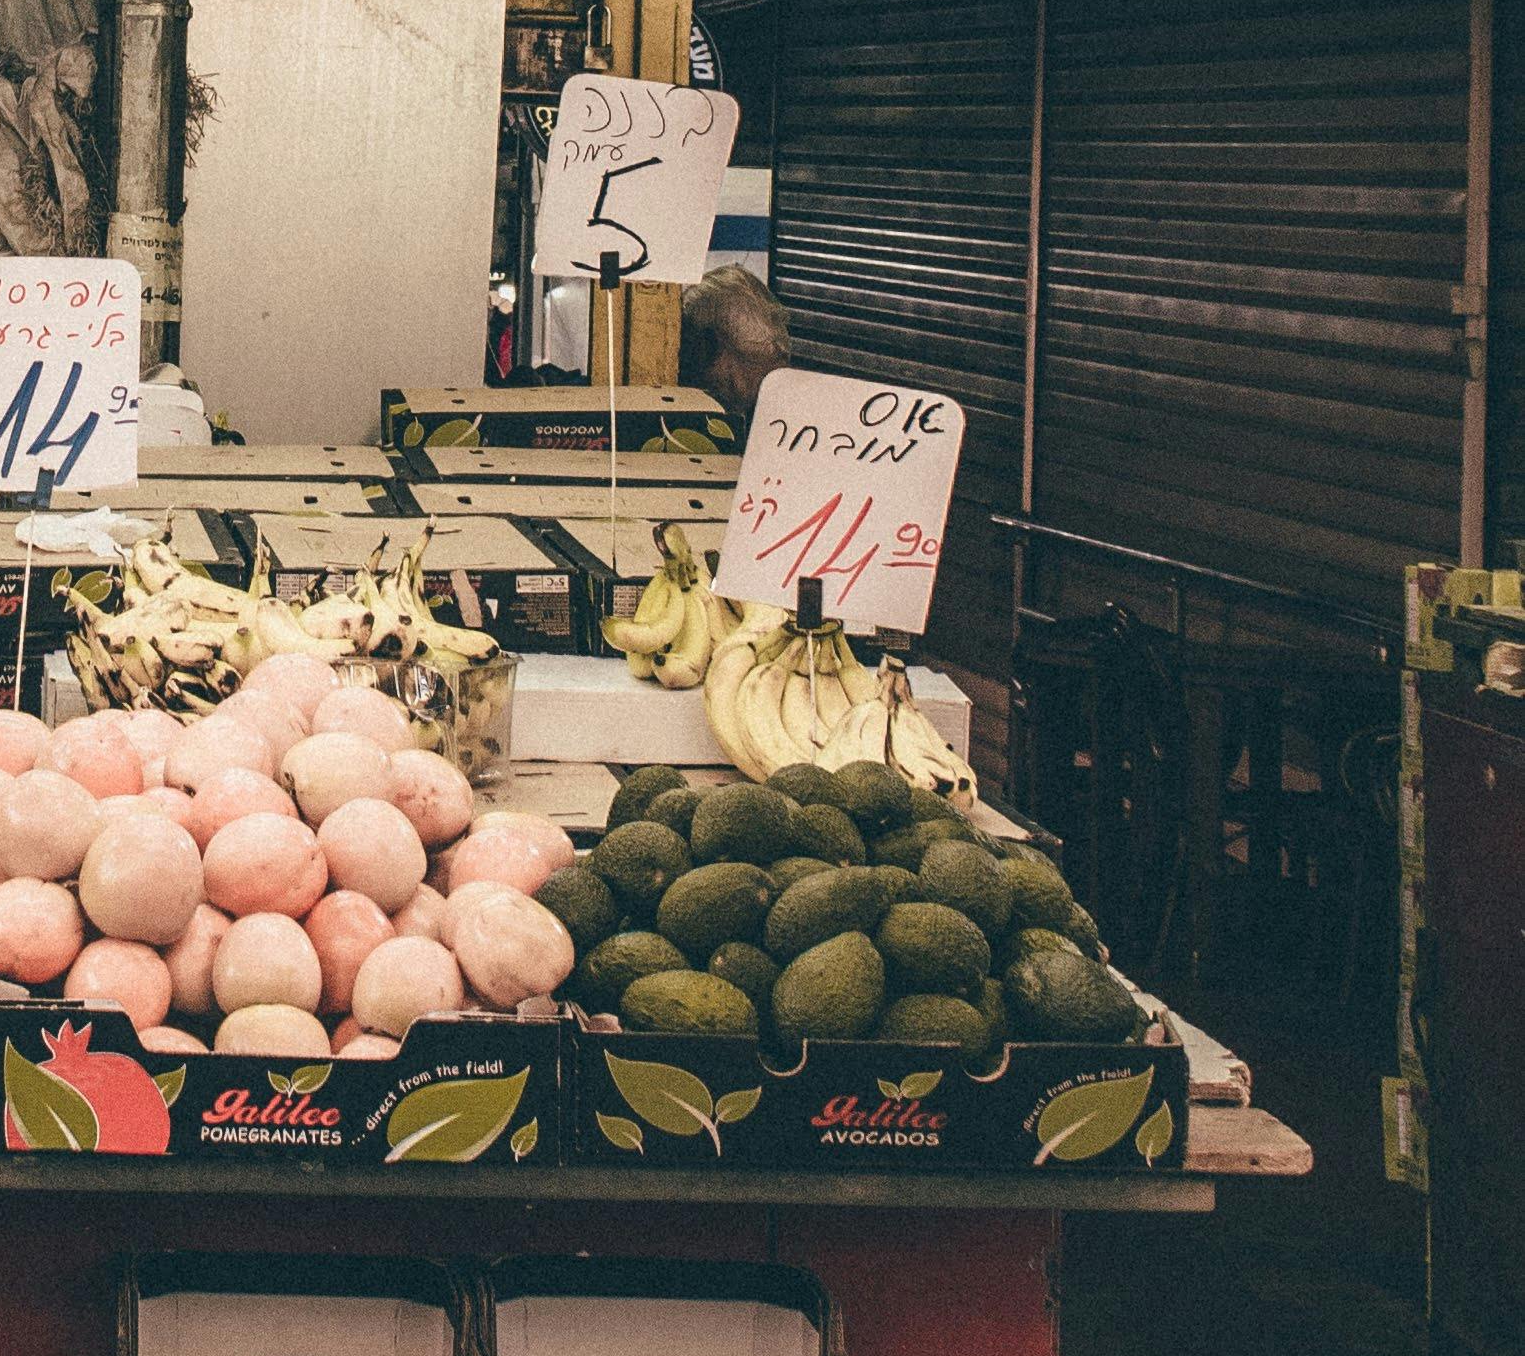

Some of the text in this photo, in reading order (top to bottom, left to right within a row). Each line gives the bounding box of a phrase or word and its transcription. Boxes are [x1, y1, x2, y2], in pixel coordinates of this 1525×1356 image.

[582, 85, 714, 147] בננה
[570, 156, 663, 277] 5
[769, 418, 918, 464] מובחר
[755, 492, 880, 606] 14
[201, 1088, 342, 1126] Galilee
[365, 1092, 398, 1131] direct
[399, 1069, 433, 1093] from
[436, 1064, 460, 1078] the
[200, 1126, 342, 1146] POMEGRANATES
[819, 1130, 940, 1147] AVOCADOS
